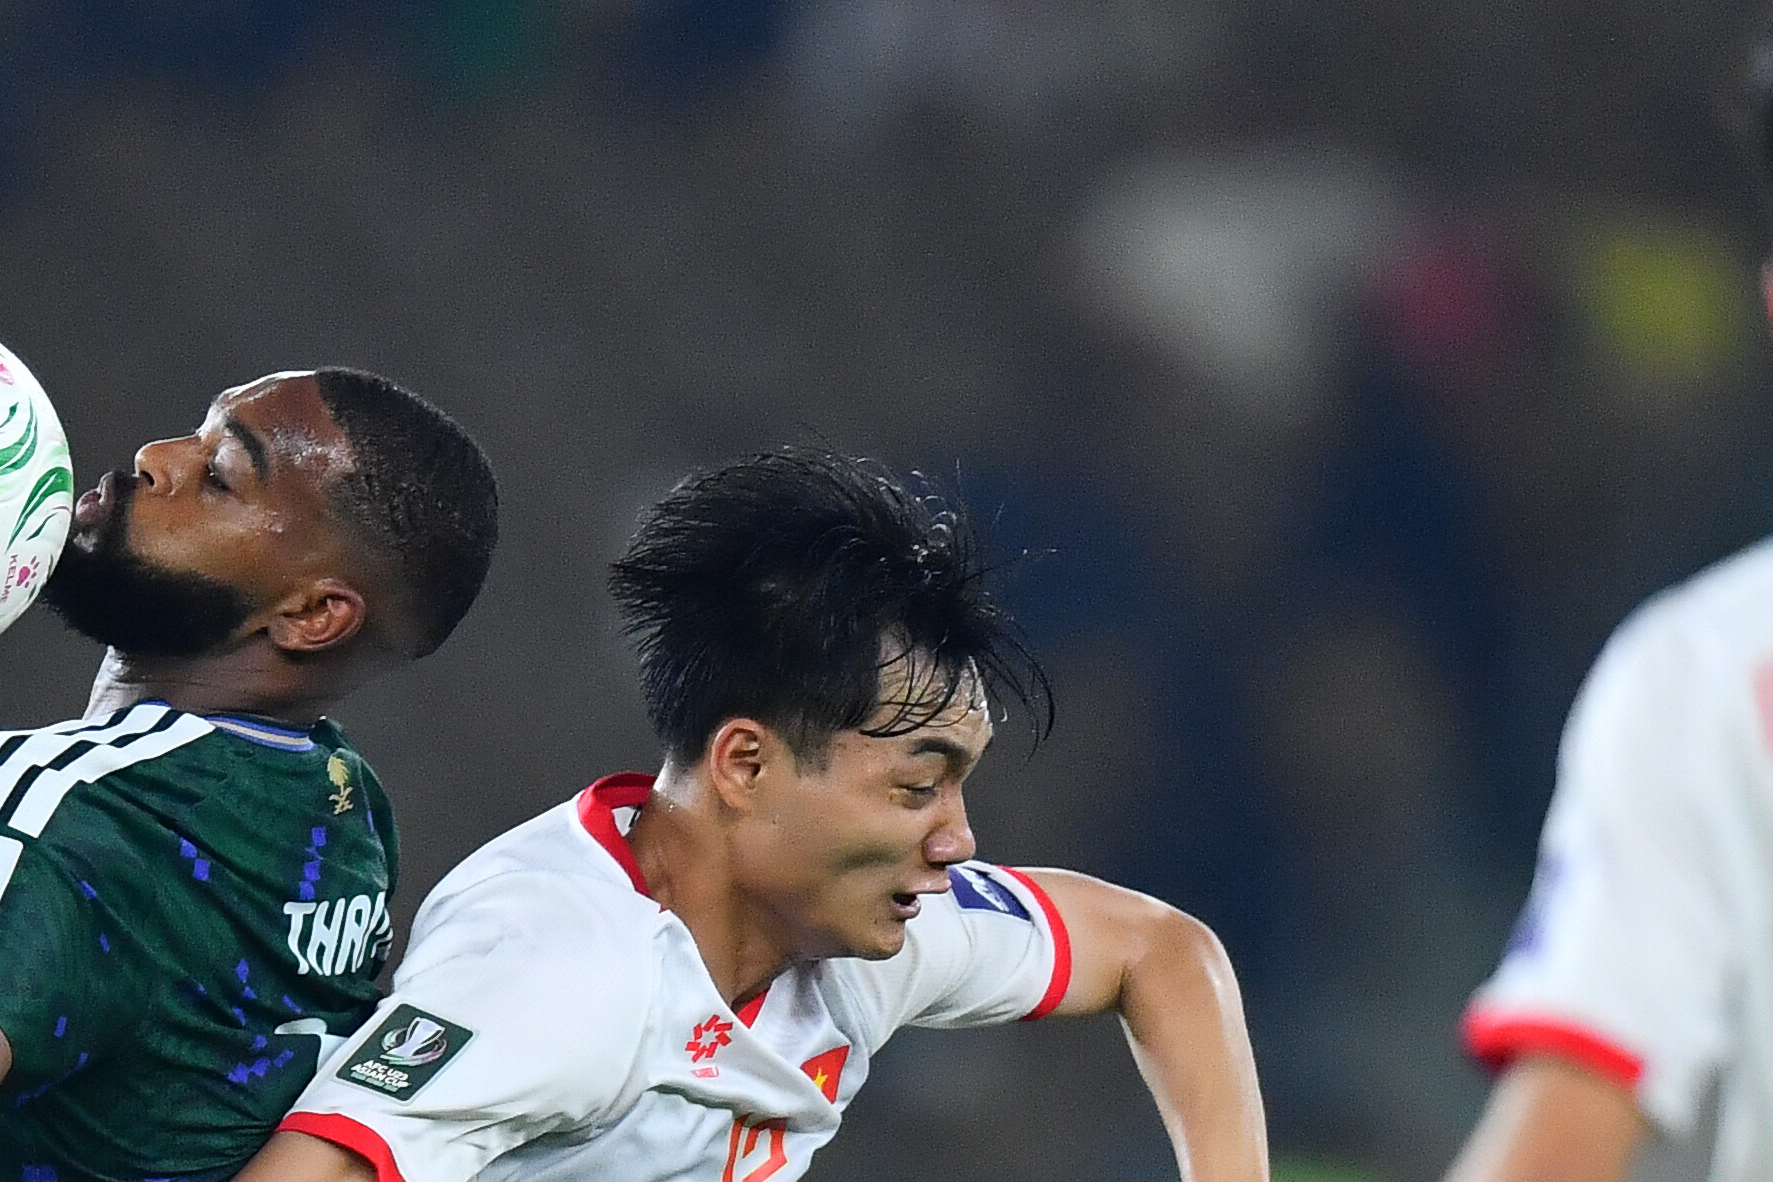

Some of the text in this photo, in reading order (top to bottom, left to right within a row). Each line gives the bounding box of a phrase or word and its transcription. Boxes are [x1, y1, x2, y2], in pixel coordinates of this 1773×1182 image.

[350, 1063, 388, 1082] ASIAN
[385, 1077, 412, 1089] CUP
[362, 1060, 409, 1081] AFC U23
